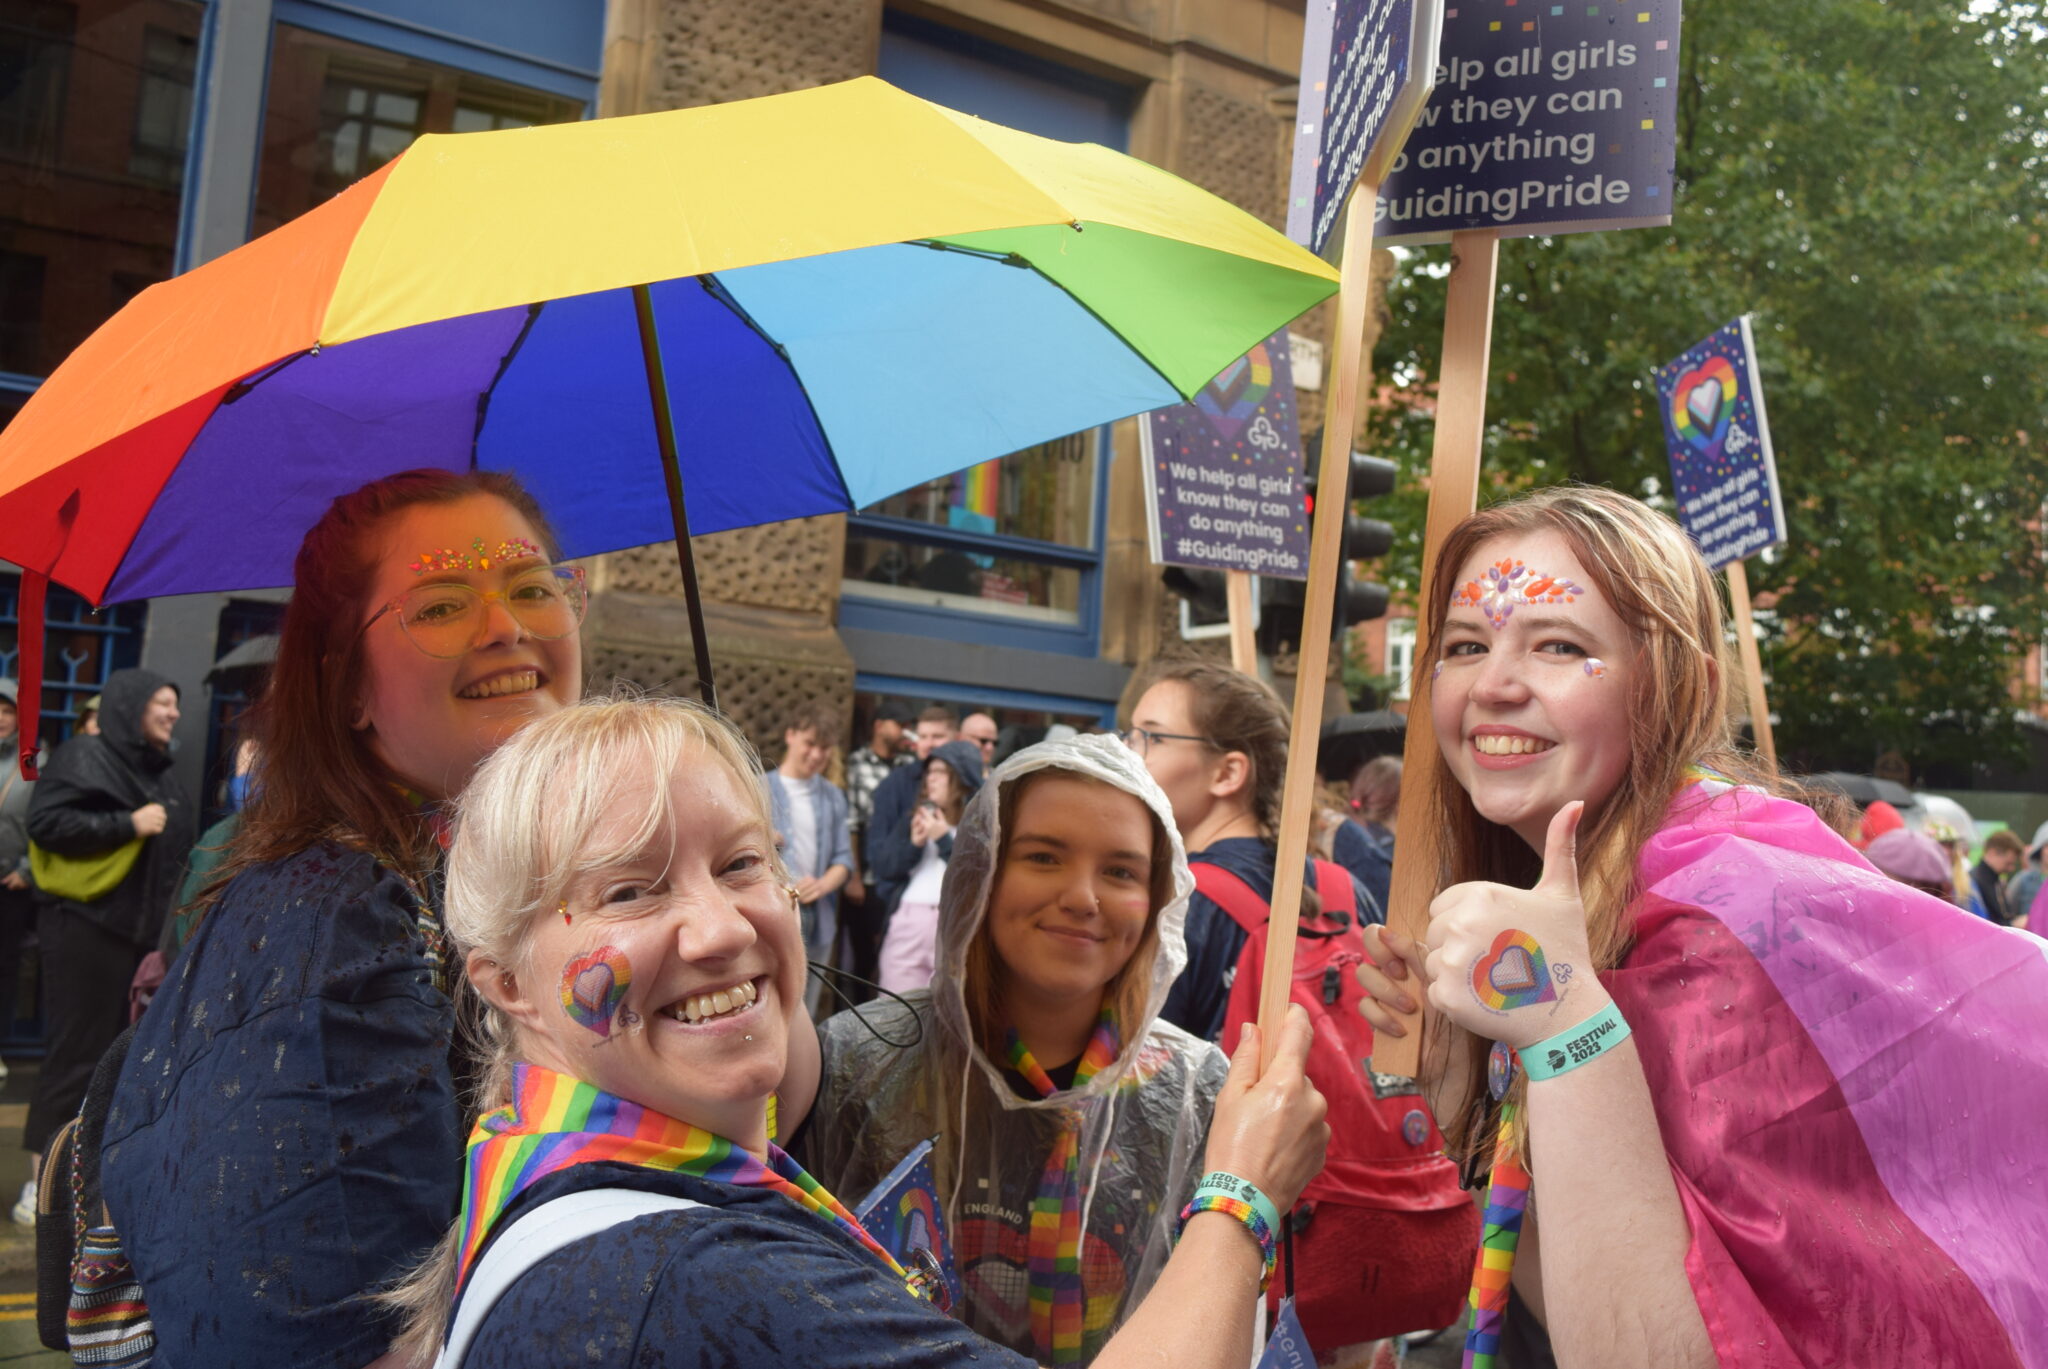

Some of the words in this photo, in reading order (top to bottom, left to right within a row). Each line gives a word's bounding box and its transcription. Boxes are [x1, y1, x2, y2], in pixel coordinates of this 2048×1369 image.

[1433, 57, 1485, 91] elp
[1494, 47, 1541, 79] all
[1551, 40, 1637, 82] girls
[1327, 145, 1341, 184] do
[1341, 33, 1390, 153] anything
[1451, 95, 1537, 127] they
[1547, 87, 1623, 115] can
[1418, 131, 1595, 173] anything
[1373, 174, 1631, 223] GuidingPride
[1169, 461, 1198, 481] We
[1200, 464, 1236, 490] help
[1237, 472, 1257, 489] all
[1259, 477, 1291, 497] girls
[1177, 486, 1220, 506] know
[1223, 492, 1259, 517] they
[1260, 501, 1290, 518] can
[1189, 513, 1211, 531] do
[1213, 517, 1285, 546] anything
[1703, 527, 1769, 566] GuidingPride
[1176, 537, 1299, 570] #GuidingPride
[1565, 1018, 1617, 1054] FESTIVAL
[1571, 1041, 1602, 1063] 2023
[1211, 1172, 1240, 1186] 2023
[964, 1203, 1023, 1225] ENGLAND
